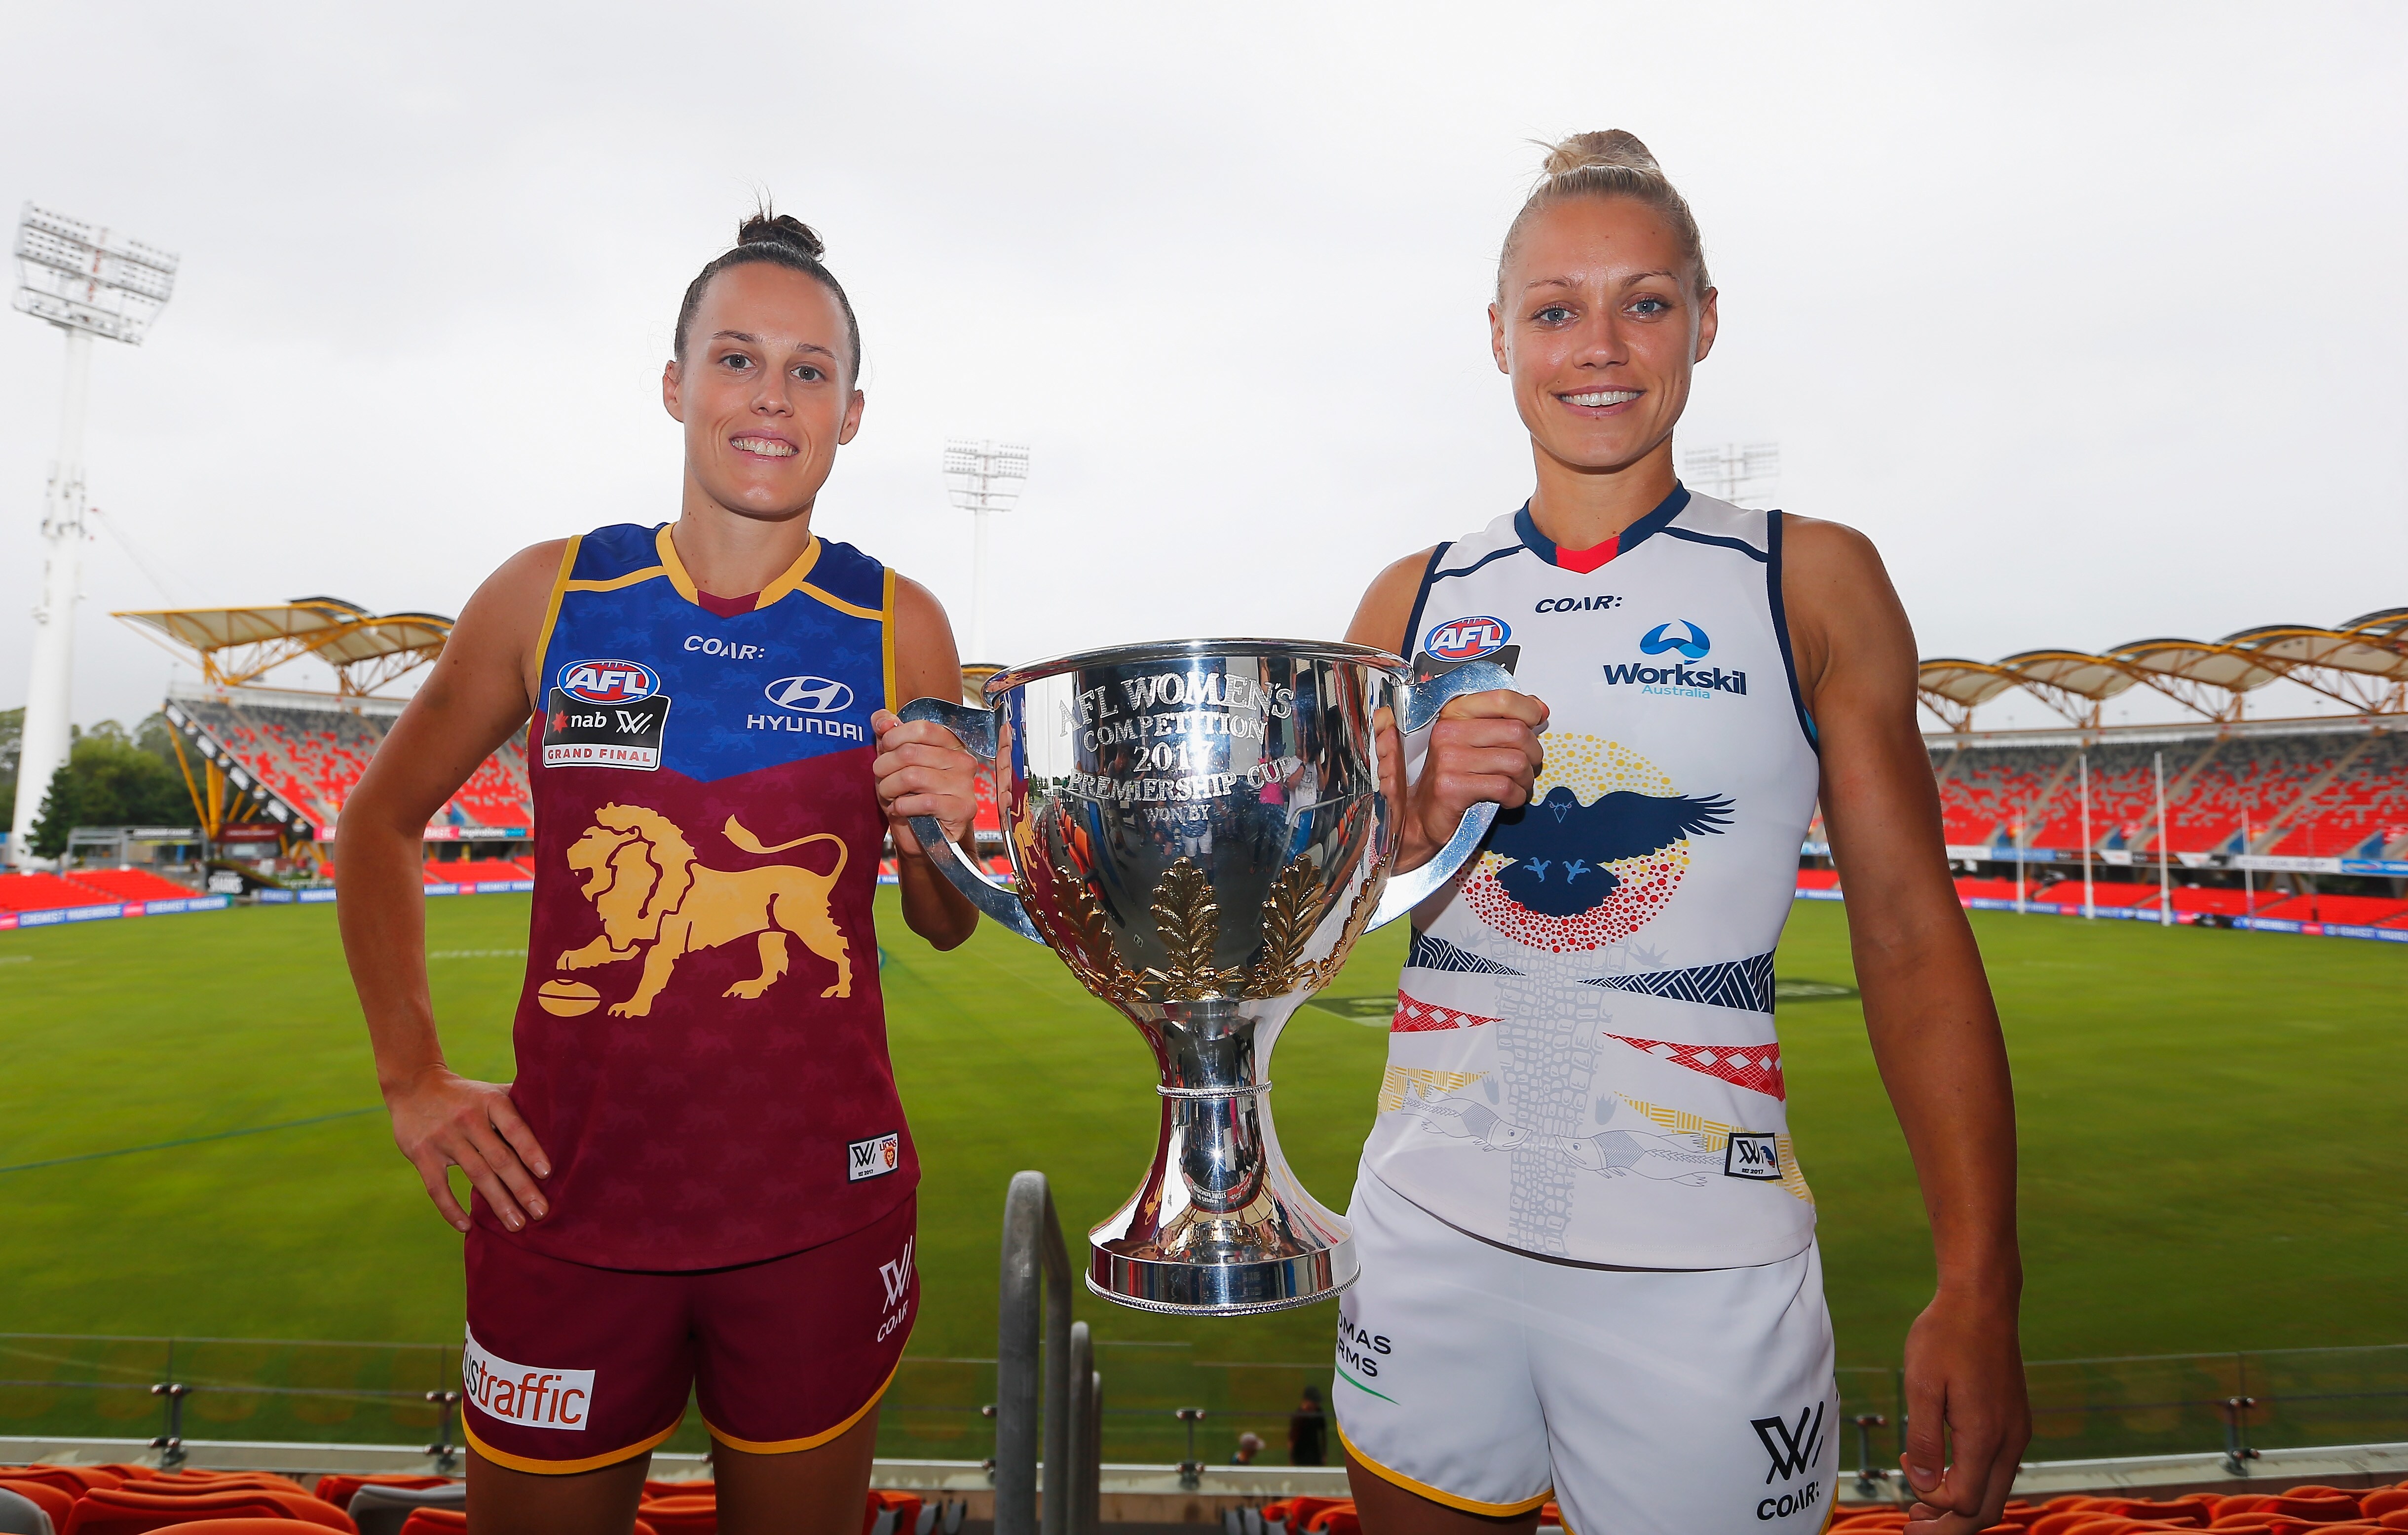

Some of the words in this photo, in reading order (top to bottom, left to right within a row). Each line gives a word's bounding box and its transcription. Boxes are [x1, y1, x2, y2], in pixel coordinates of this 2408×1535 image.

[1535, 595, 1622, 613] COAR:
[683, 635, 765, 659] COAR:
[1429, 624, 1501, 651] AFL
[564, 667, 647, 695] AFL
[1603, 663, 1747, 695] Workskil
[1641, 685, 1711, 699] Australia
[1058, 685, 1119, 737] AFL
[1120, 671, 1294, 719] WOMEN'S
[571, 711, 607, 728] nab
[747, 714, 864, 742] HYUNDAI
[1083, 710, 1268, 753] COMPETITION
[548, 748, 593, 760] GRAND
[599, 749, 651, 762] FINAL
[1133, 740, 1215, 773] 2017
[1068, 768, 1238, 802] PREMIERSHIP
[1247, 756, 1292, 789] CUP
[1143, 806, 1187, 826] WON
[1188, 804, 1211, 821] BY
[879, 1139, 897, 1151] LIONS
[1212, 1191, 1227, 1200] STONE
[1338, 1309, 1392, 1355] OMAS
[1337, 1337, 1378, 1378] RMS
[464, 1338, 585, 1424] ustraffic
[1756, 1481, 1820, 1521] COAR:
